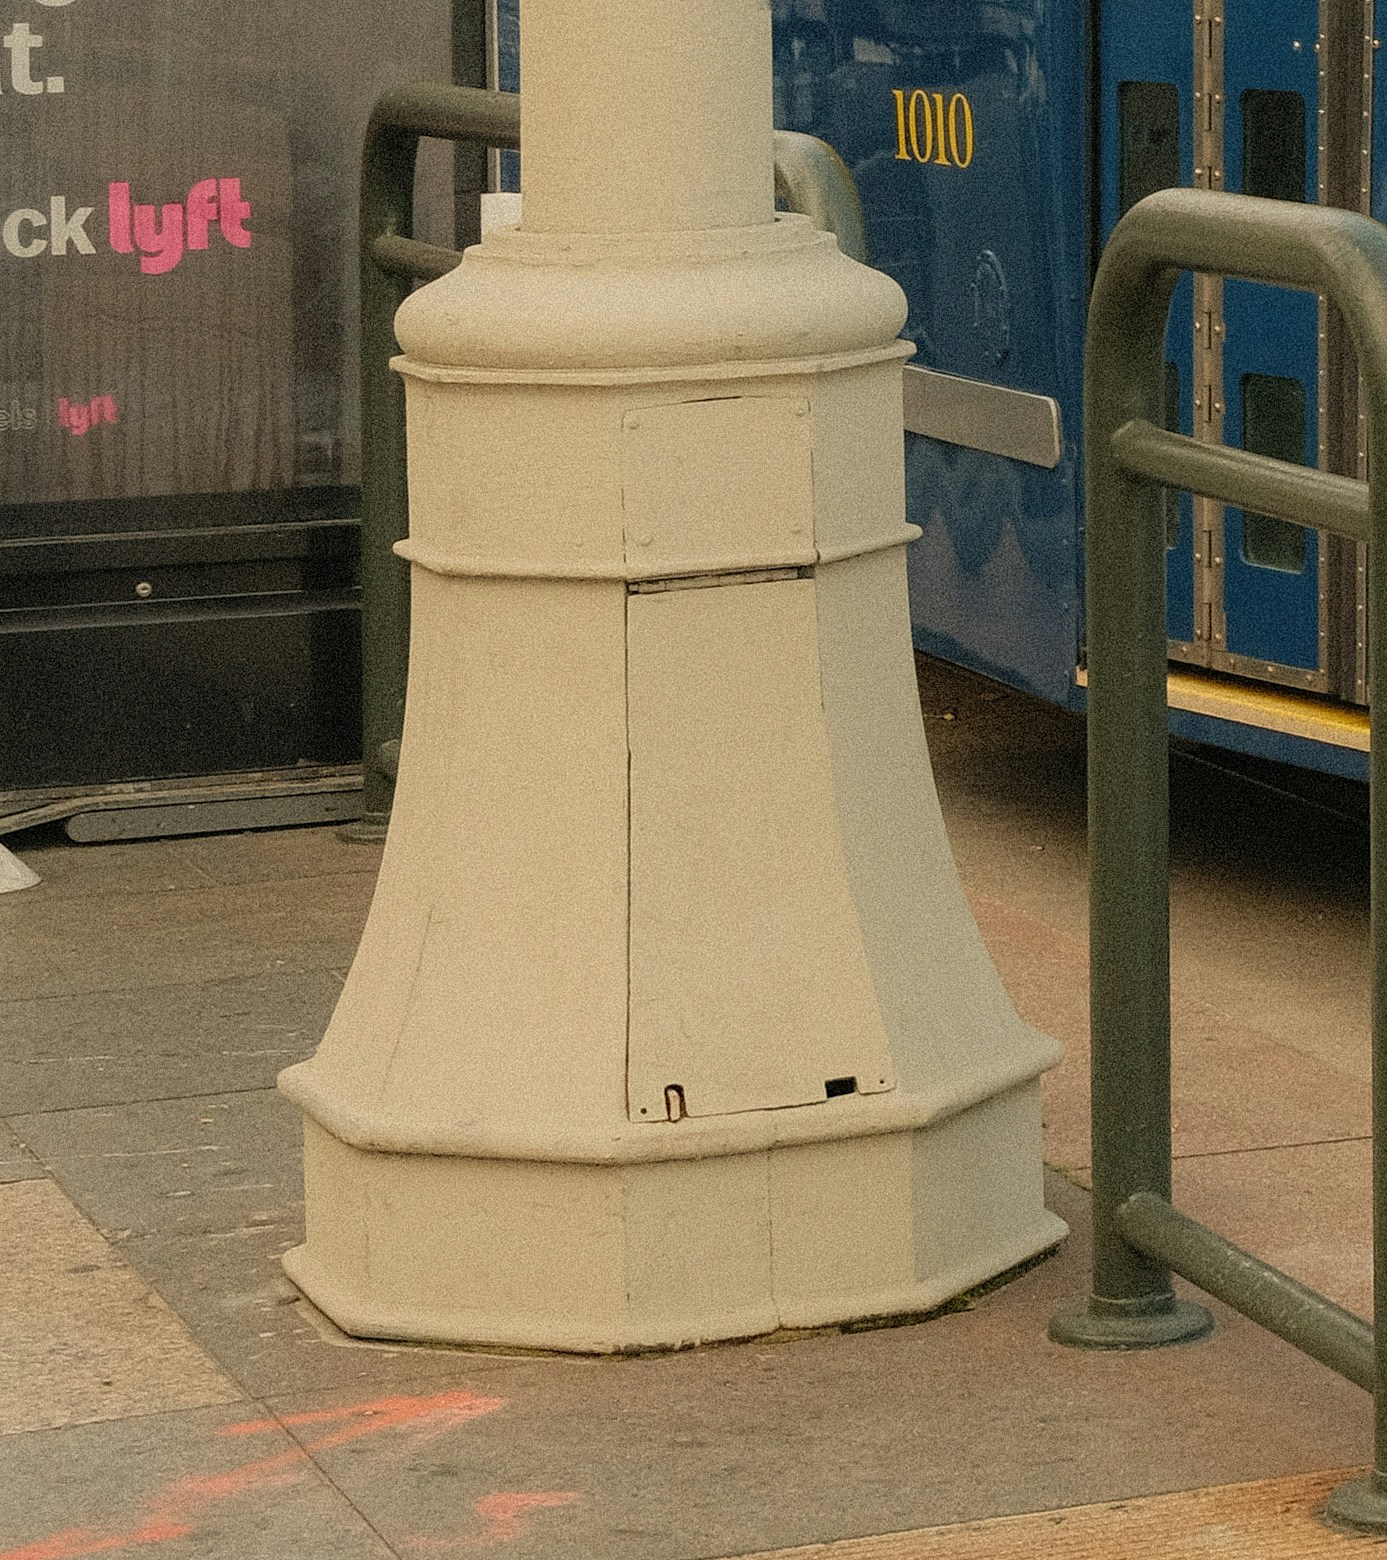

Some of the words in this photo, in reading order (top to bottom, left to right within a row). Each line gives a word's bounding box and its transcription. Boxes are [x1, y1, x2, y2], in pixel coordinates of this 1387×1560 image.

[892, 89, 974, 168] 1010
[2, 195, 97, 258] ck
[108, 177, 252, 275] lyft
[58, 393, 117, 436] lyft
